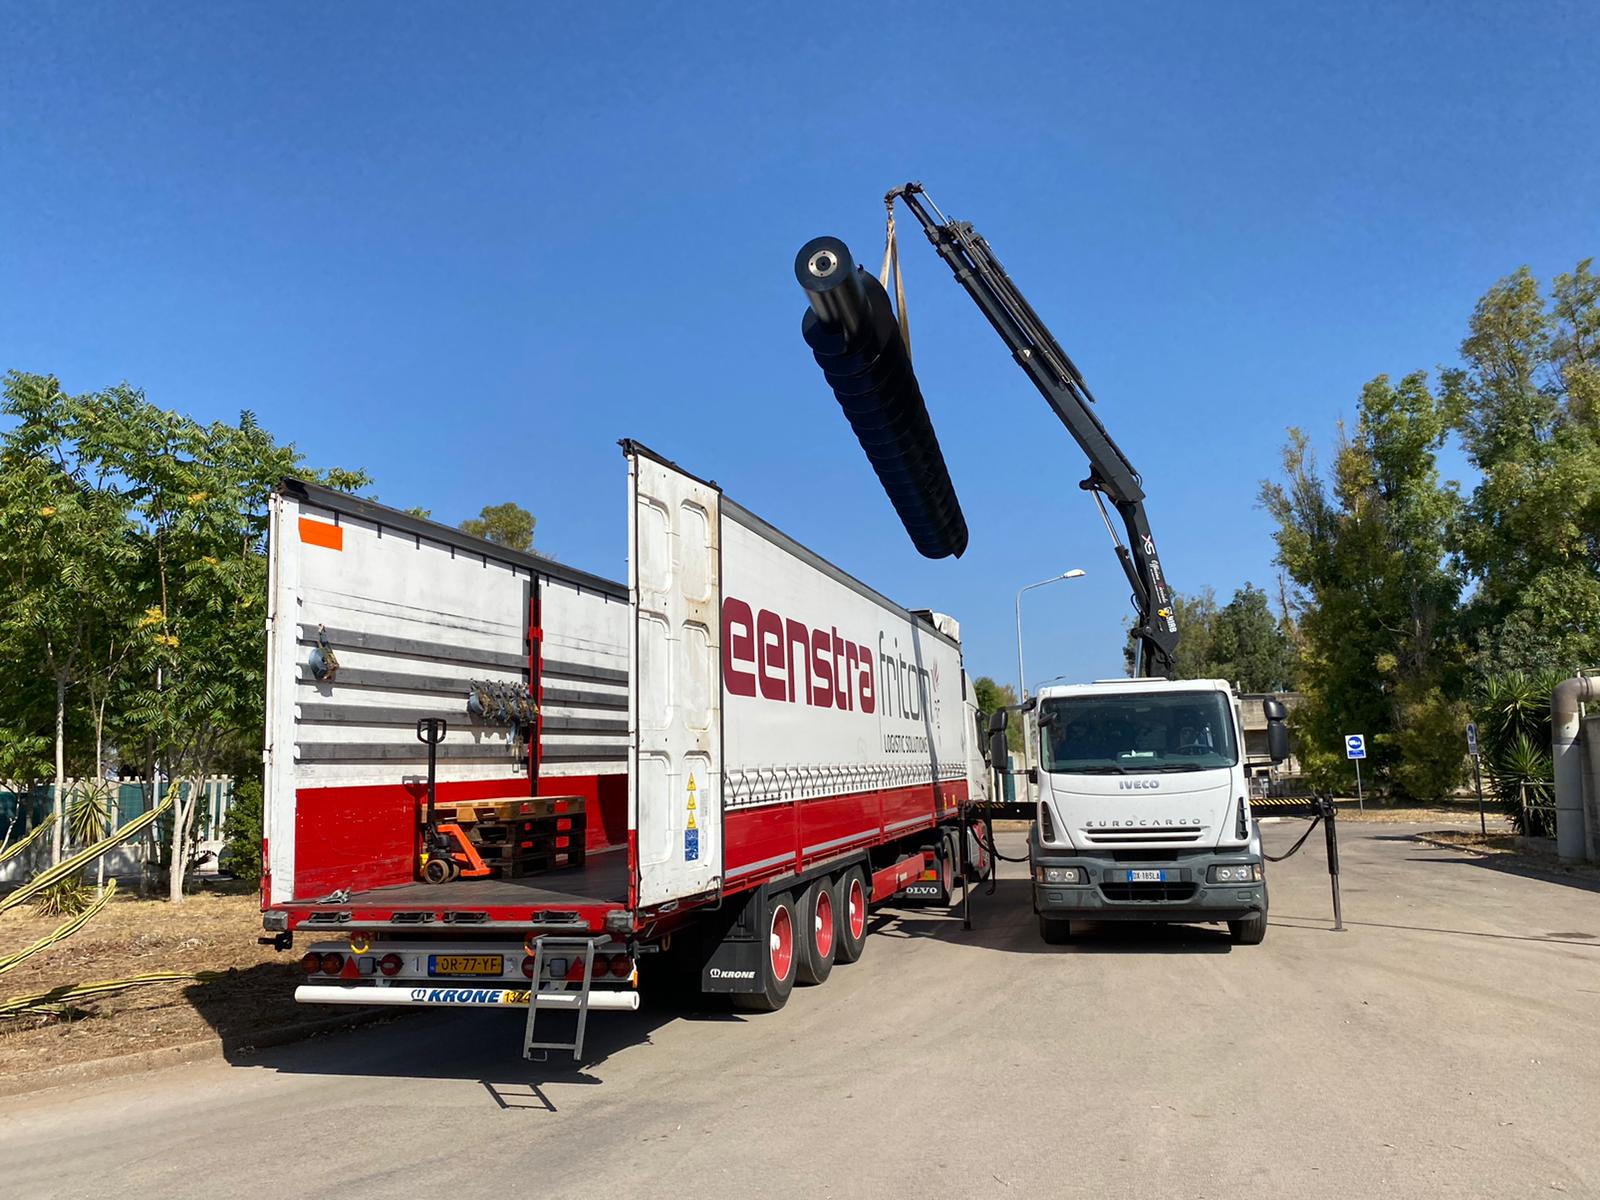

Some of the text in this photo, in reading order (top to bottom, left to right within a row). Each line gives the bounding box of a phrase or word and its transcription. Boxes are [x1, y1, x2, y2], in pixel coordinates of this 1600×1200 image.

[722, 596, 876, 714] eenstra
[878, 630, 934, 722] fritom
[1119, 780, 1160, 790] IVECO
[1086, 818, 1201, 828] EUROCARGO
[905, 887, 938, 895] OLVO
[721, 970, 756, 979] KRONE
[427, 989, 503, 1004] KRONE
